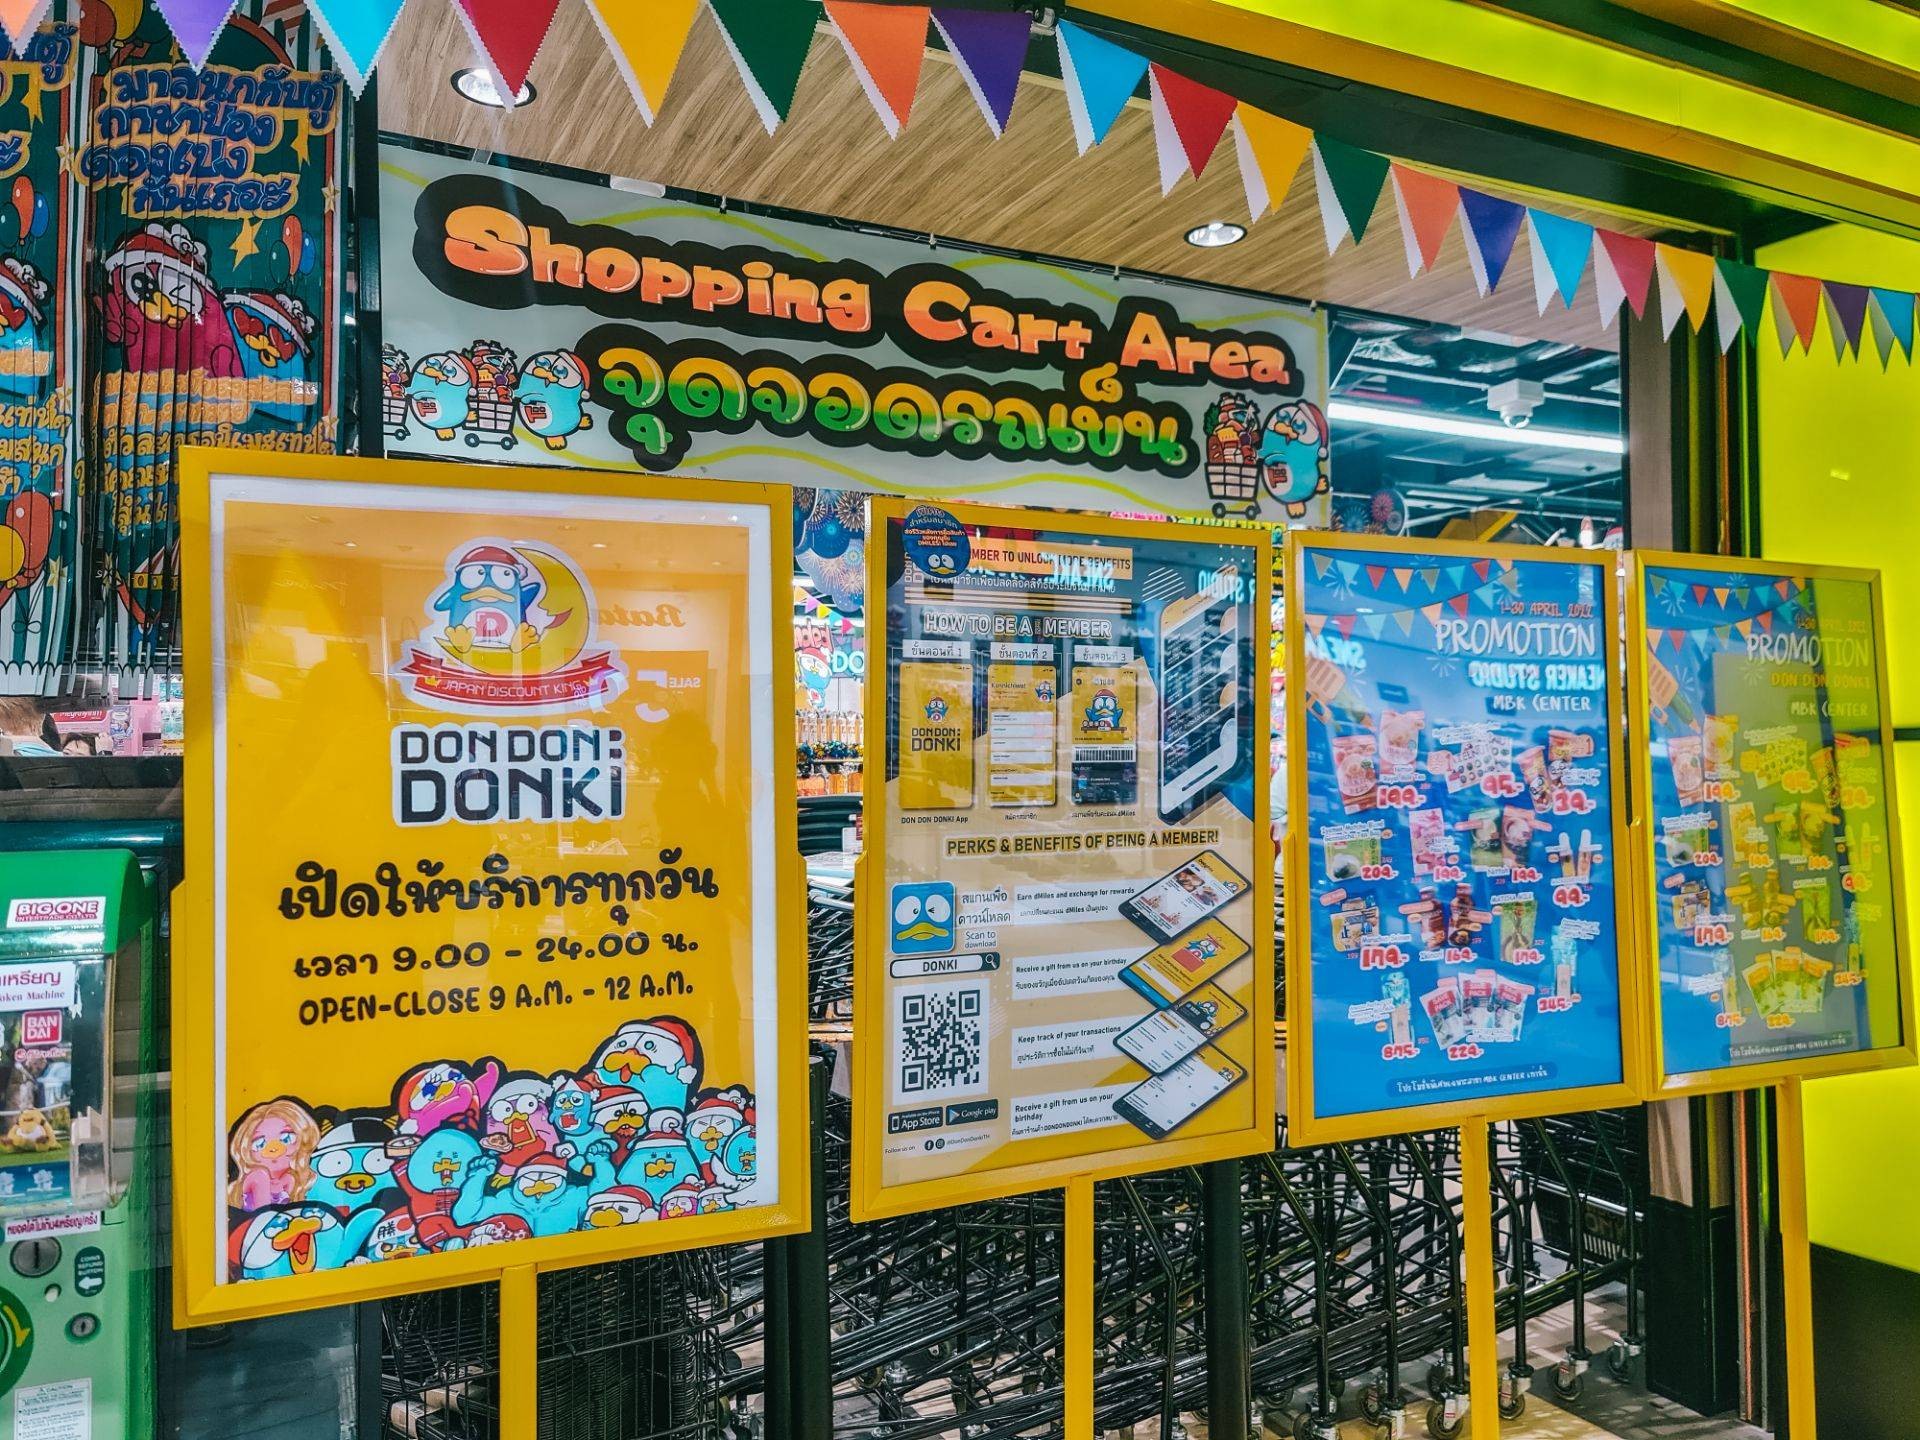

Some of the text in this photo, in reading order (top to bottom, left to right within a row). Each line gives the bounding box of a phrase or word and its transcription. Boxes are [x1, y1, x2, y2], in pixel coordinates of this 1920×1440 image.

[443, 204, 1290, 385] Shopping Cart Area
[599, 347, 1189, 466] จุดจอดรถเข็น
[1003, 550, 1015, 562] TO
[925, 613, 967, 633] HOW
[969, 614, 990, 634] TO
[994, 616, 1016, 635] BE
[1018, 618, 1032, 636] A
[1043, 618, 1112, 639] MEMBER
[1435, 618, 1595, 657] PROMOTION
[1041, 650, 1048, 659] 2
[1121, 652, 1126, 661] 3
[1746, 631, 1870, 667] PROMOTION
[1771, 672, 1798, 688] DON
[1802, 673, 1827, 688] DON
[441, 681, 484, 694] JAPAN
[487, 683, 549, 697] DISCOUNT
[1493, 693, 1591, 712] MBK CENTER
[1791, 701, 1868, 717] MBK CENTER
[911, 737, 961, 752] DONKI
[400, 765, 623, 823] DONKI
[901, 815, 968, 824] DON DON DONKI App
[947, 830, 1219, 855] PERKS & BENEFITS OF BEING A MEMBER!
[278, 847, 720, 926] เปิดให้บริการทุกวัน
[1017, 887, 1135, 901] Earn dMiles and exchange for rewards
[962, 887, 1008, 904] สแกนเพื่อ
[18, 901, 99, 916] BIG ONE
[958, 907, 1011, 926] ดาวน์โหลด
[1066, 906, 1085, 915] dMiles
[965, 930, 996, 940] Scan to
[965, 940, 996, 949] download
[294, 952, 379, 978] เวลา
[393, 942, 491, 972] 9.00
[535, 931, 650, 963] 24.00
[662, 933, 700, 953] น.
[922, 959, 958, 973] DONKI
[1016, 965, 1038, 974] Receive
[1046, 963, 1056, 972] gift
[1090, 960, 1103, 969] your
[1104, 957, 1127, 967] birthday
[0, 968, 62, 987] เหรียญ
[27, 989, 65, 1000] Machine
[299, 985, 480, 1026] OPEN-CLOSE
[489, 985, 505, 1010] 9
[515, 979, 573, 1009] A.M.
[604, 975, 630, 1001] 12
[639, 970, 694, 998] A.M.
[27, 1016, 58, 1029] BAN
[26, 1027, 51, 1040] DAI
[1018, 1026, 1121, 1044] Keep track of your transactions
[1015, 1102, 1042, 1113] Receive
[1049, 1099, 1060, 1110] gift
[1062, 1097, 1078, 1106] from
[1099, 1093, 1114, 1103] your
[901, 1106, 997, 1131] App Store Google play
[1015, 1111, 1043, 1123] birthday
[884, 1146, 901, 1154] Follow
